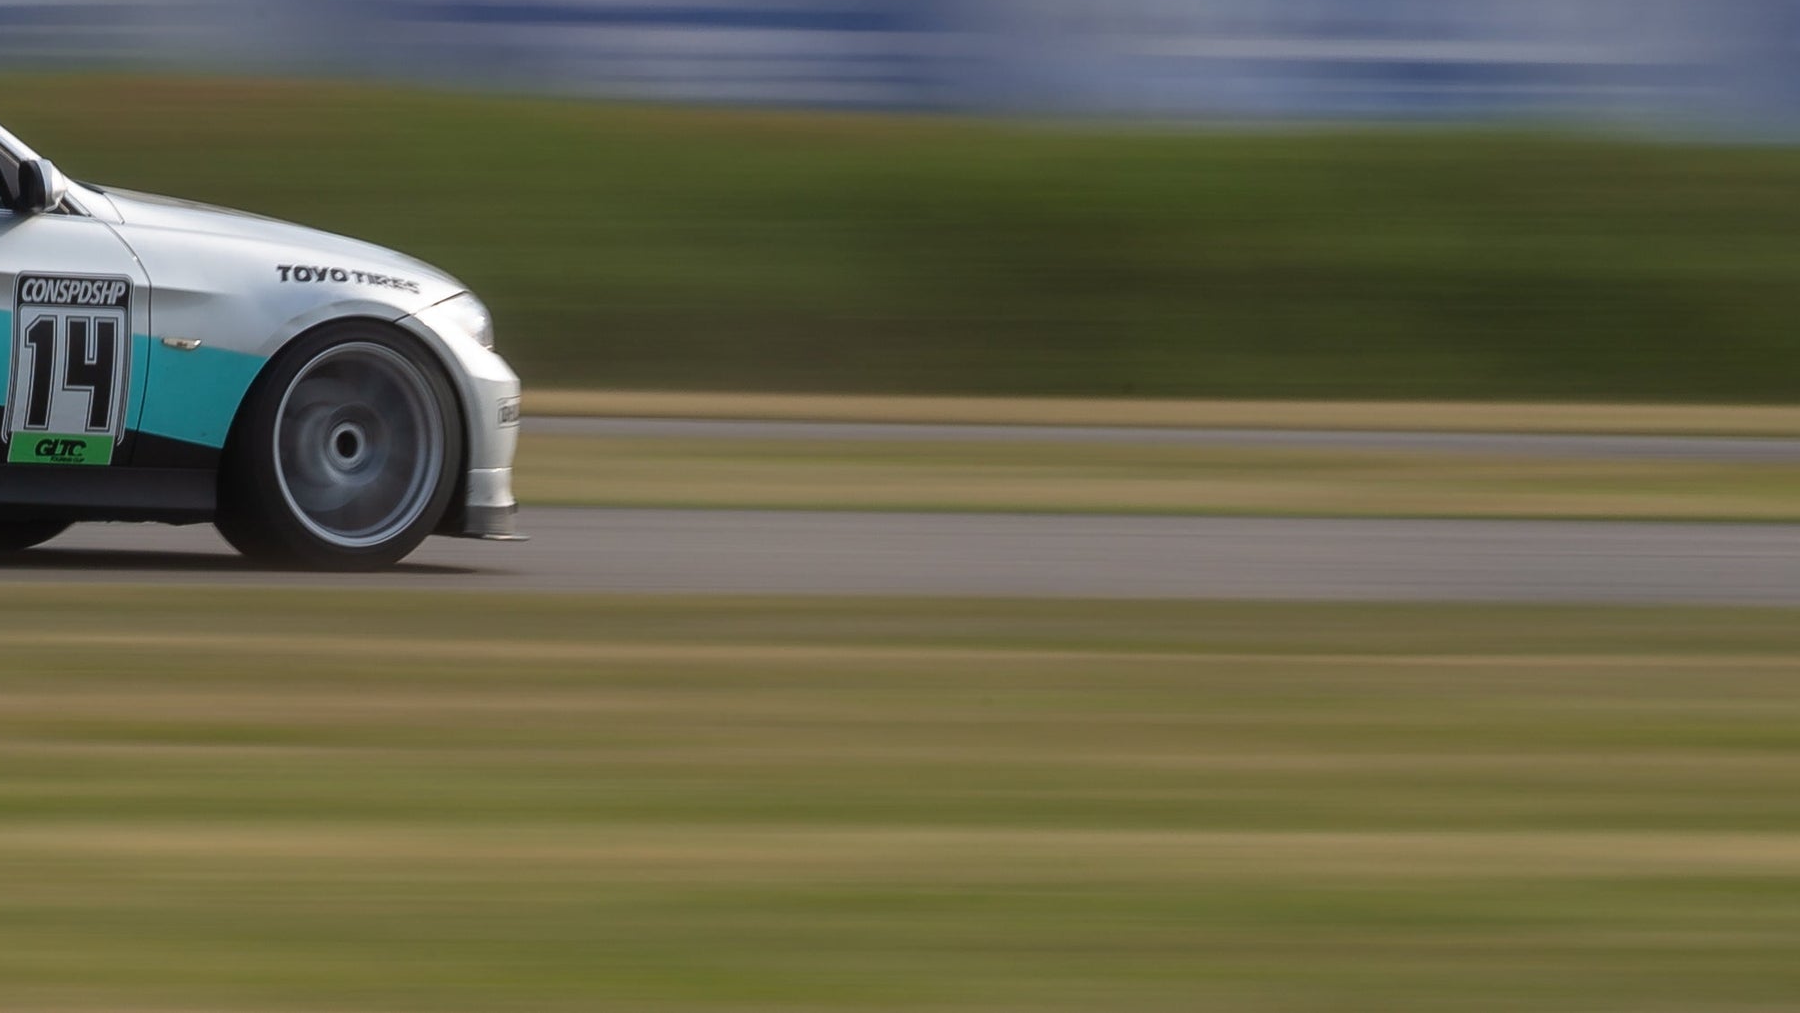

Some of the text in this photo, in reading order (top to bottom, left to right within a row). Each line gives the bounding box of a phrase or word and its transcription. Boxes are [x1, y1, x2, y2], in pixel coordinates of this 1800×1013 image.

[21, 277, 126, 306] CONSPDSHP
[277, 264, 421, 295] TOYO TIRES
[24, 315, 118, 434] 14
[35, 438, 87, 457] GLTC
